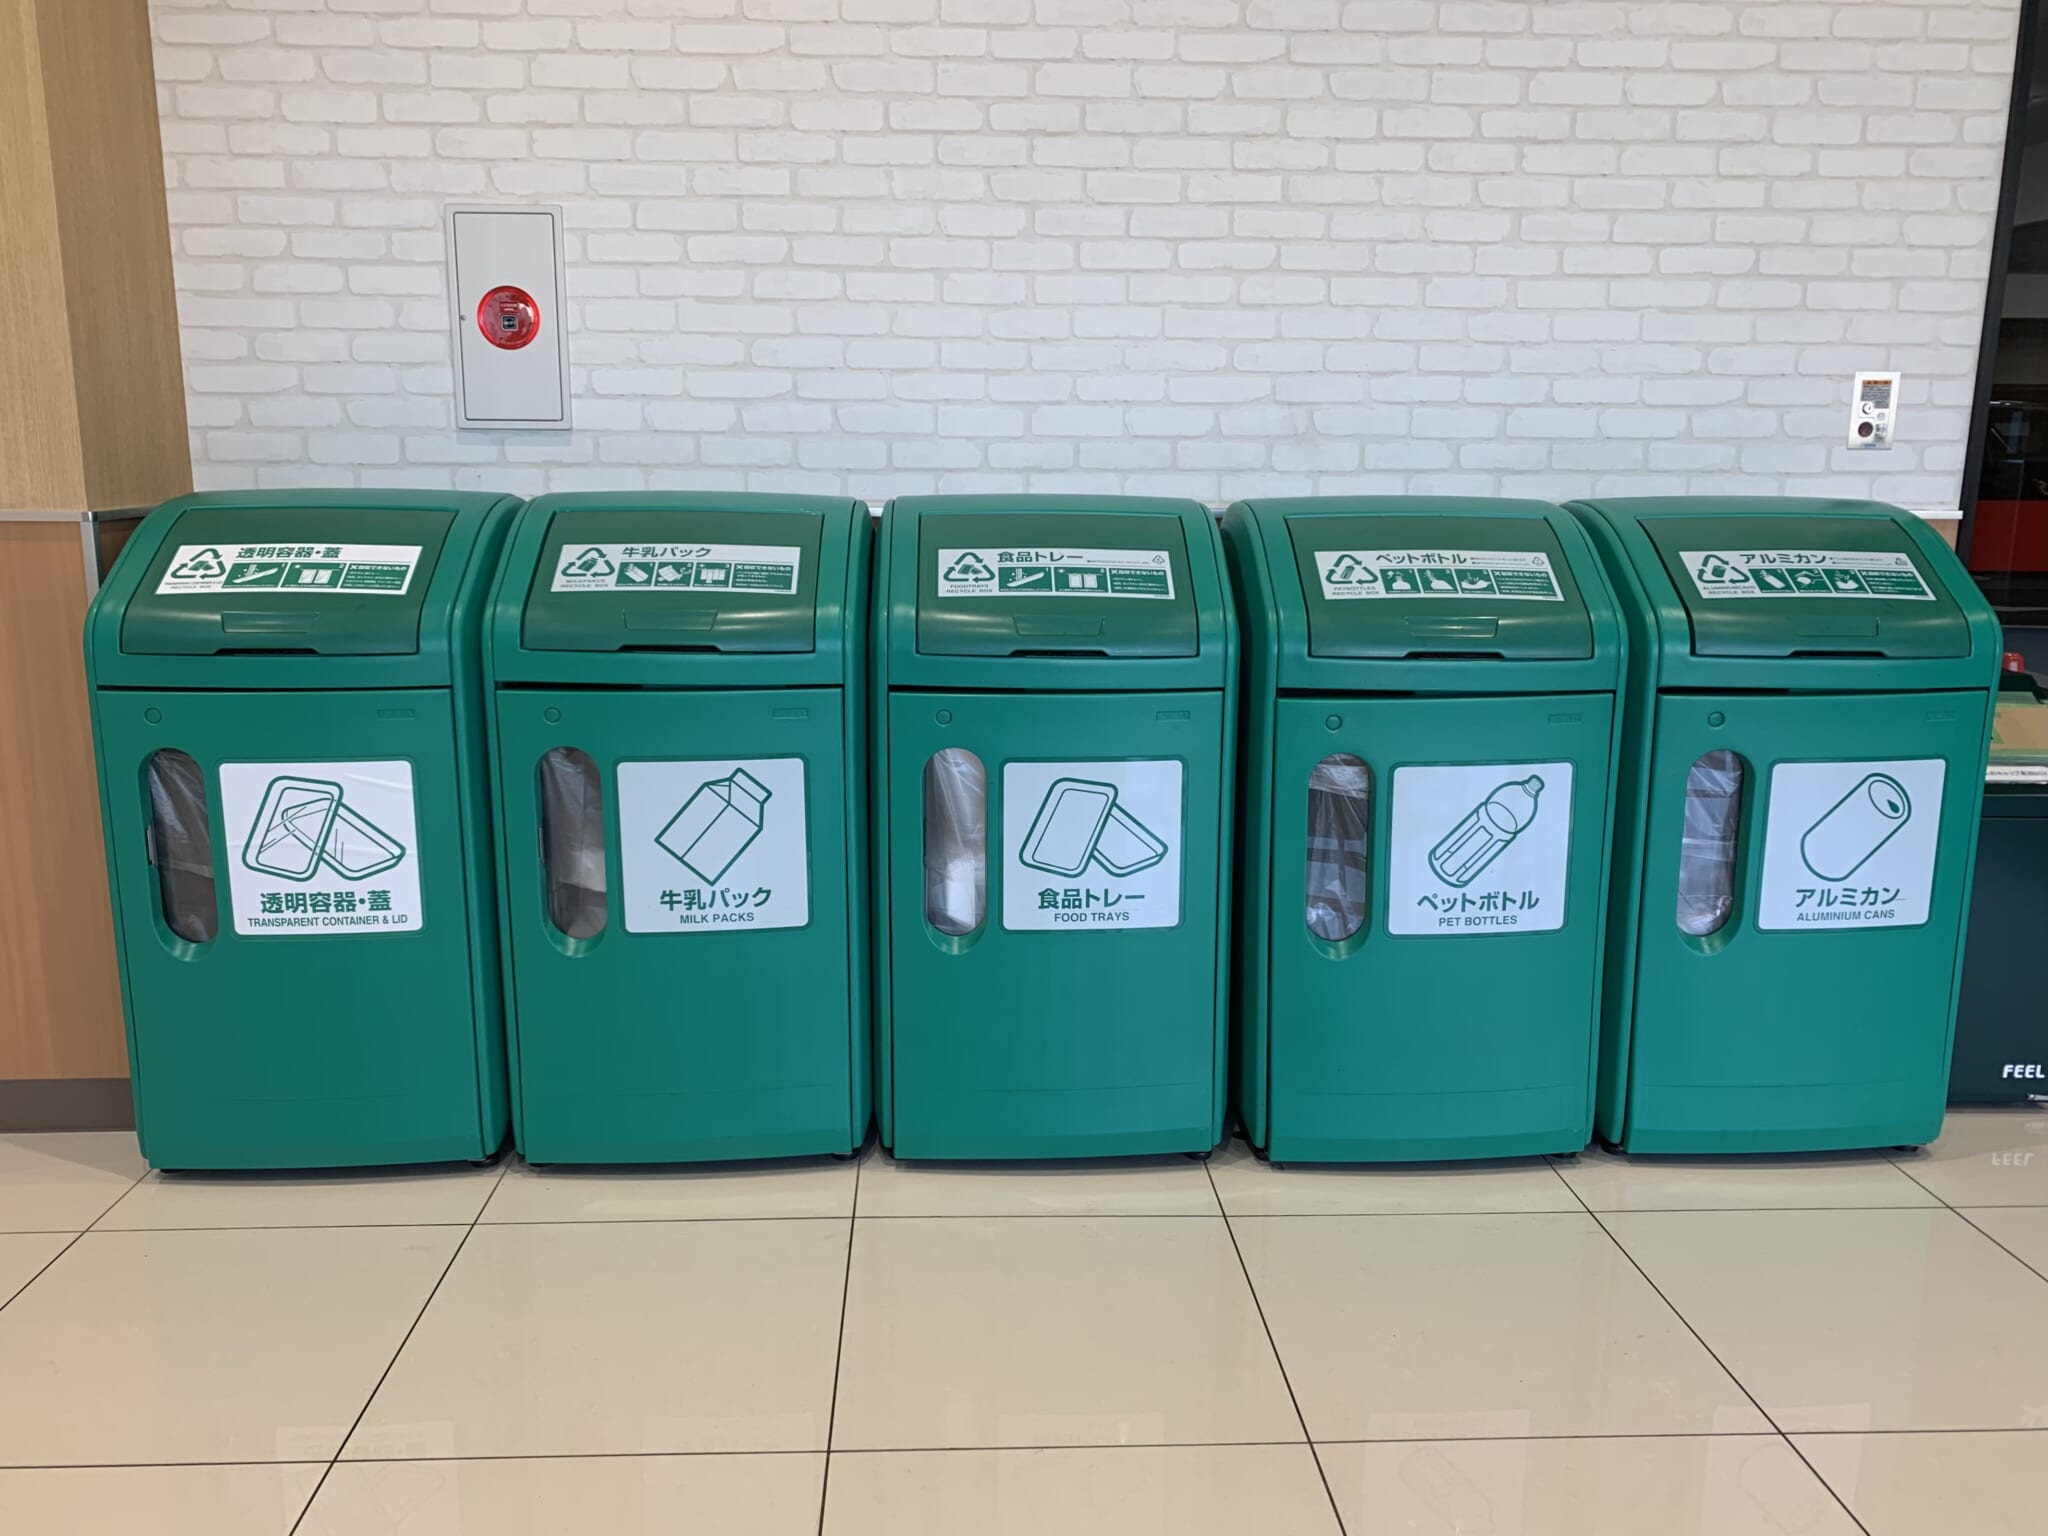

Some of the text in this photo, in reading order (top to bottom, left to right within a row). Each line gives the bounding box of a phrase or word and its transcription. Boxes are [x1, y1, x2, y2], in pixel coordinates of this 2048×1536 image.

[997, 551, 1084, 563] 食品トレー
[1376, 552, 1467, 564] ペットボトル
[1739, 553, 1826, 564] アルミカン
[659, 886, 772, 911] 牛乳パック
[1038, 887, 1145, 910] 食品トレー
[1417, 890, 1540, 913] ペットボトル
[1795, 886, 1900, 908] アルミカン
[248, 914, 408, 928] TRANSPARENT CONTAINER & LID
[680, 912, 755, 925] MILK PACKS
[1054, 911, 1130, 923] FOOD TRAYS
[1438, 915, 1518, 927] PET BOTTLES
[1797, 909, 1895, 922] ALUMINIUM CANS
[2002, 1064, 2046, 1079] FEEL
